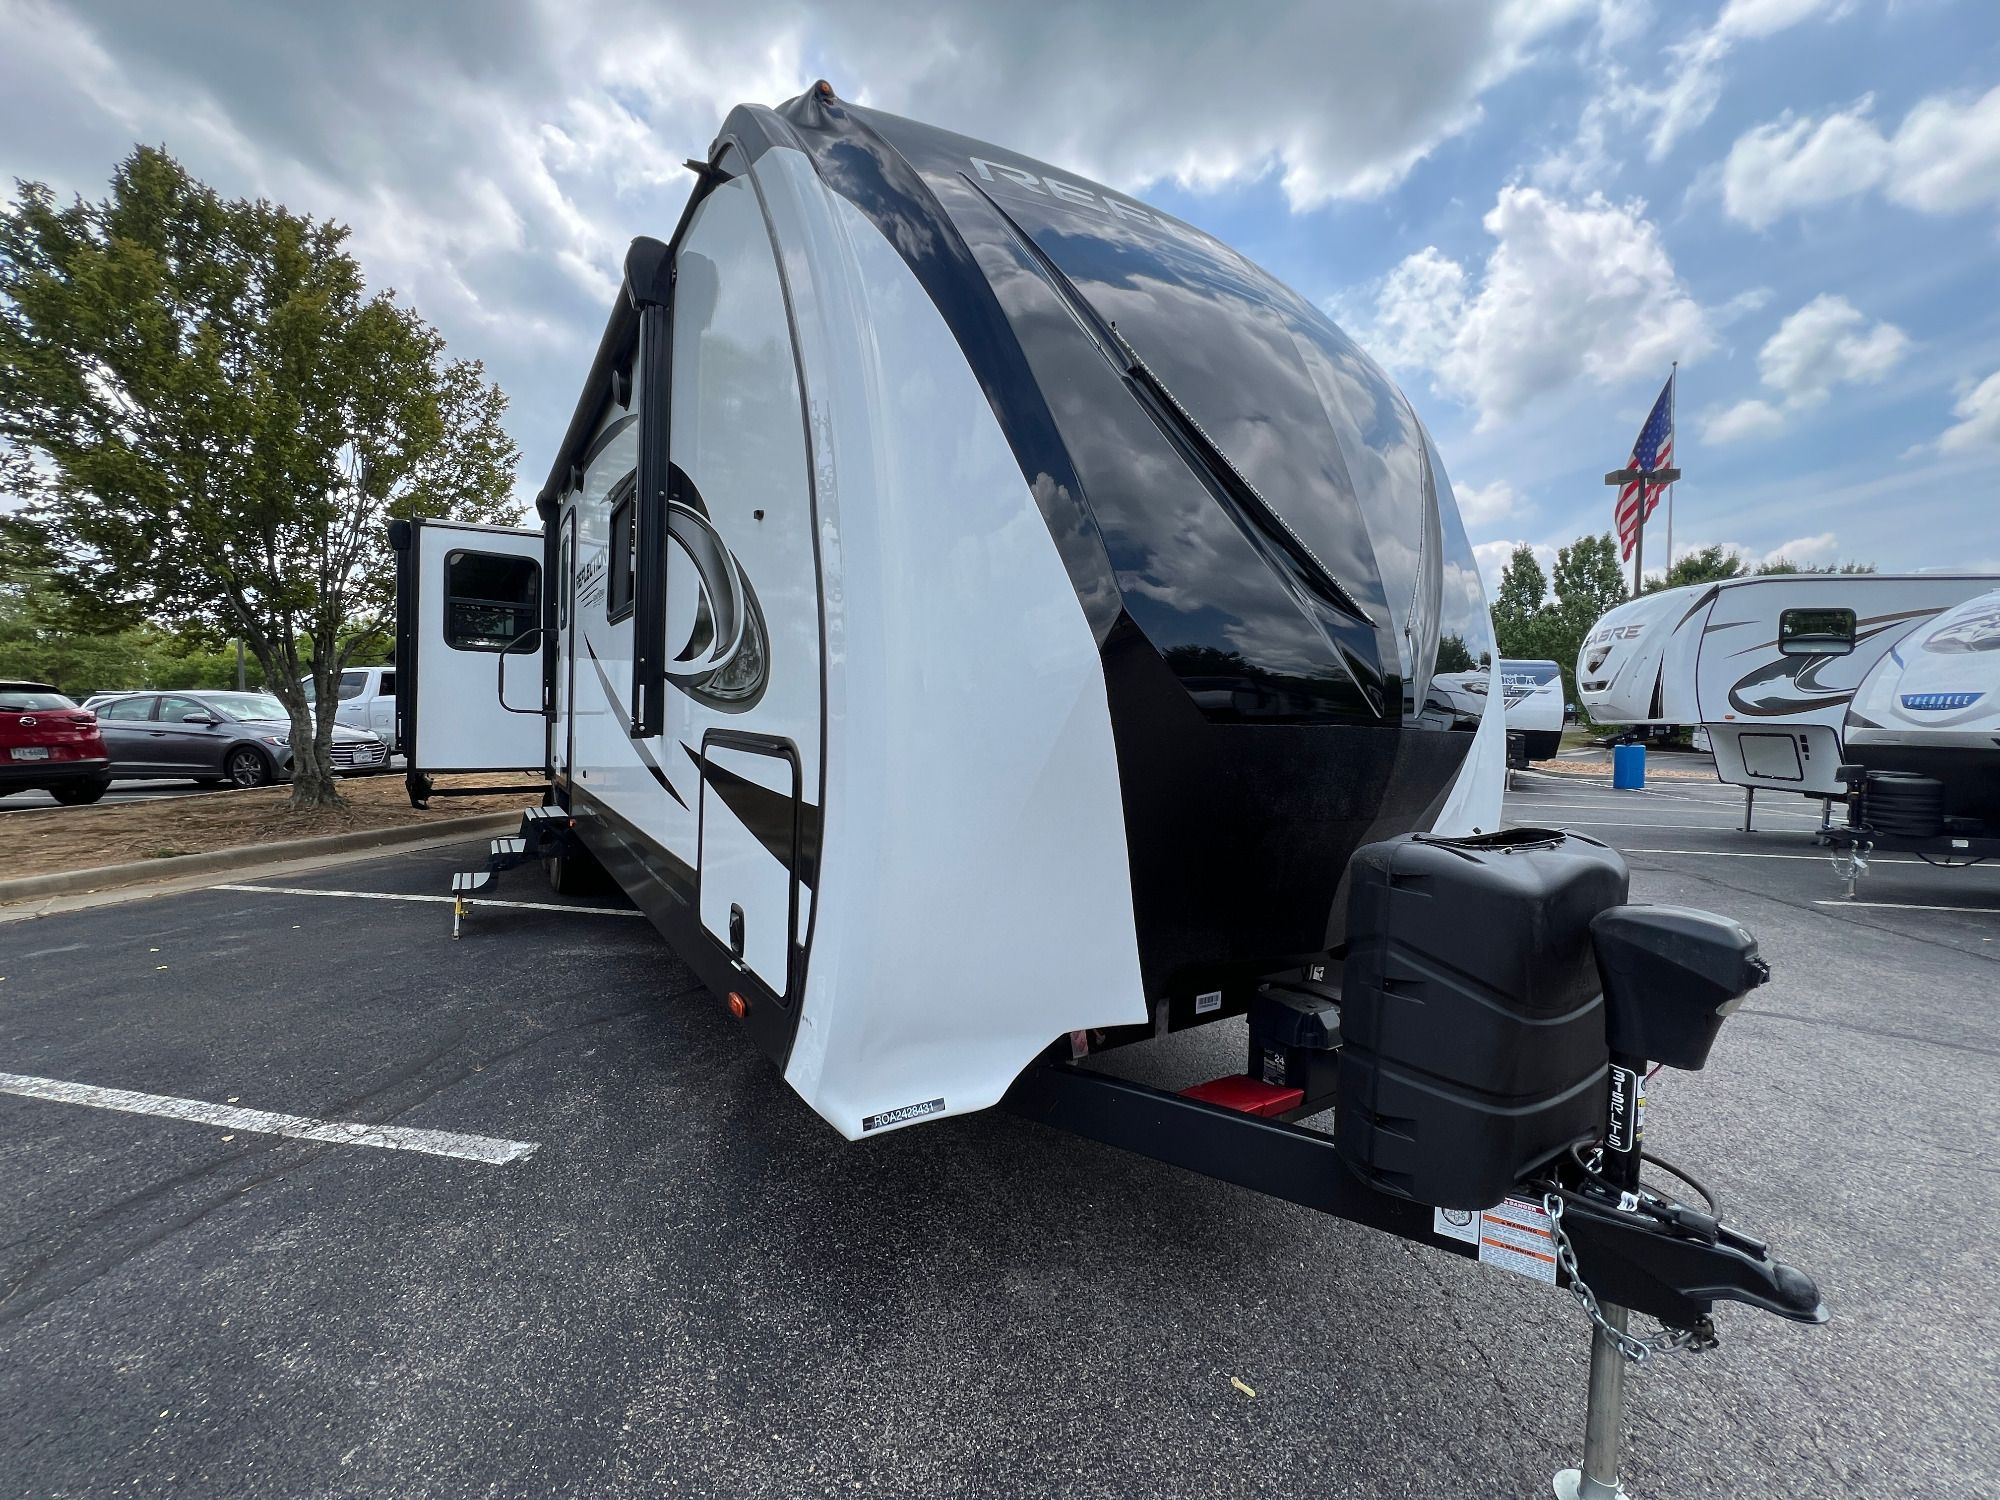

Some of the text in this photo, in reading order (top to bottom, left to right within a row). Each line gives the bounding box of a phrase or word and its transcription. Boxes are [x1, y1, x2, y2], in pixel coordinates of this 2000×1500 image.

[1907, 695, 1970, 706] CHEROKEE
[874, 1102, 934, 1128] ROA2428431
[1509, 1201, 1537, 1213] DANGER
[1506, 1221, 1538, 1235] WARNING
[1505, 1243, 1536, 1258] WARNING
